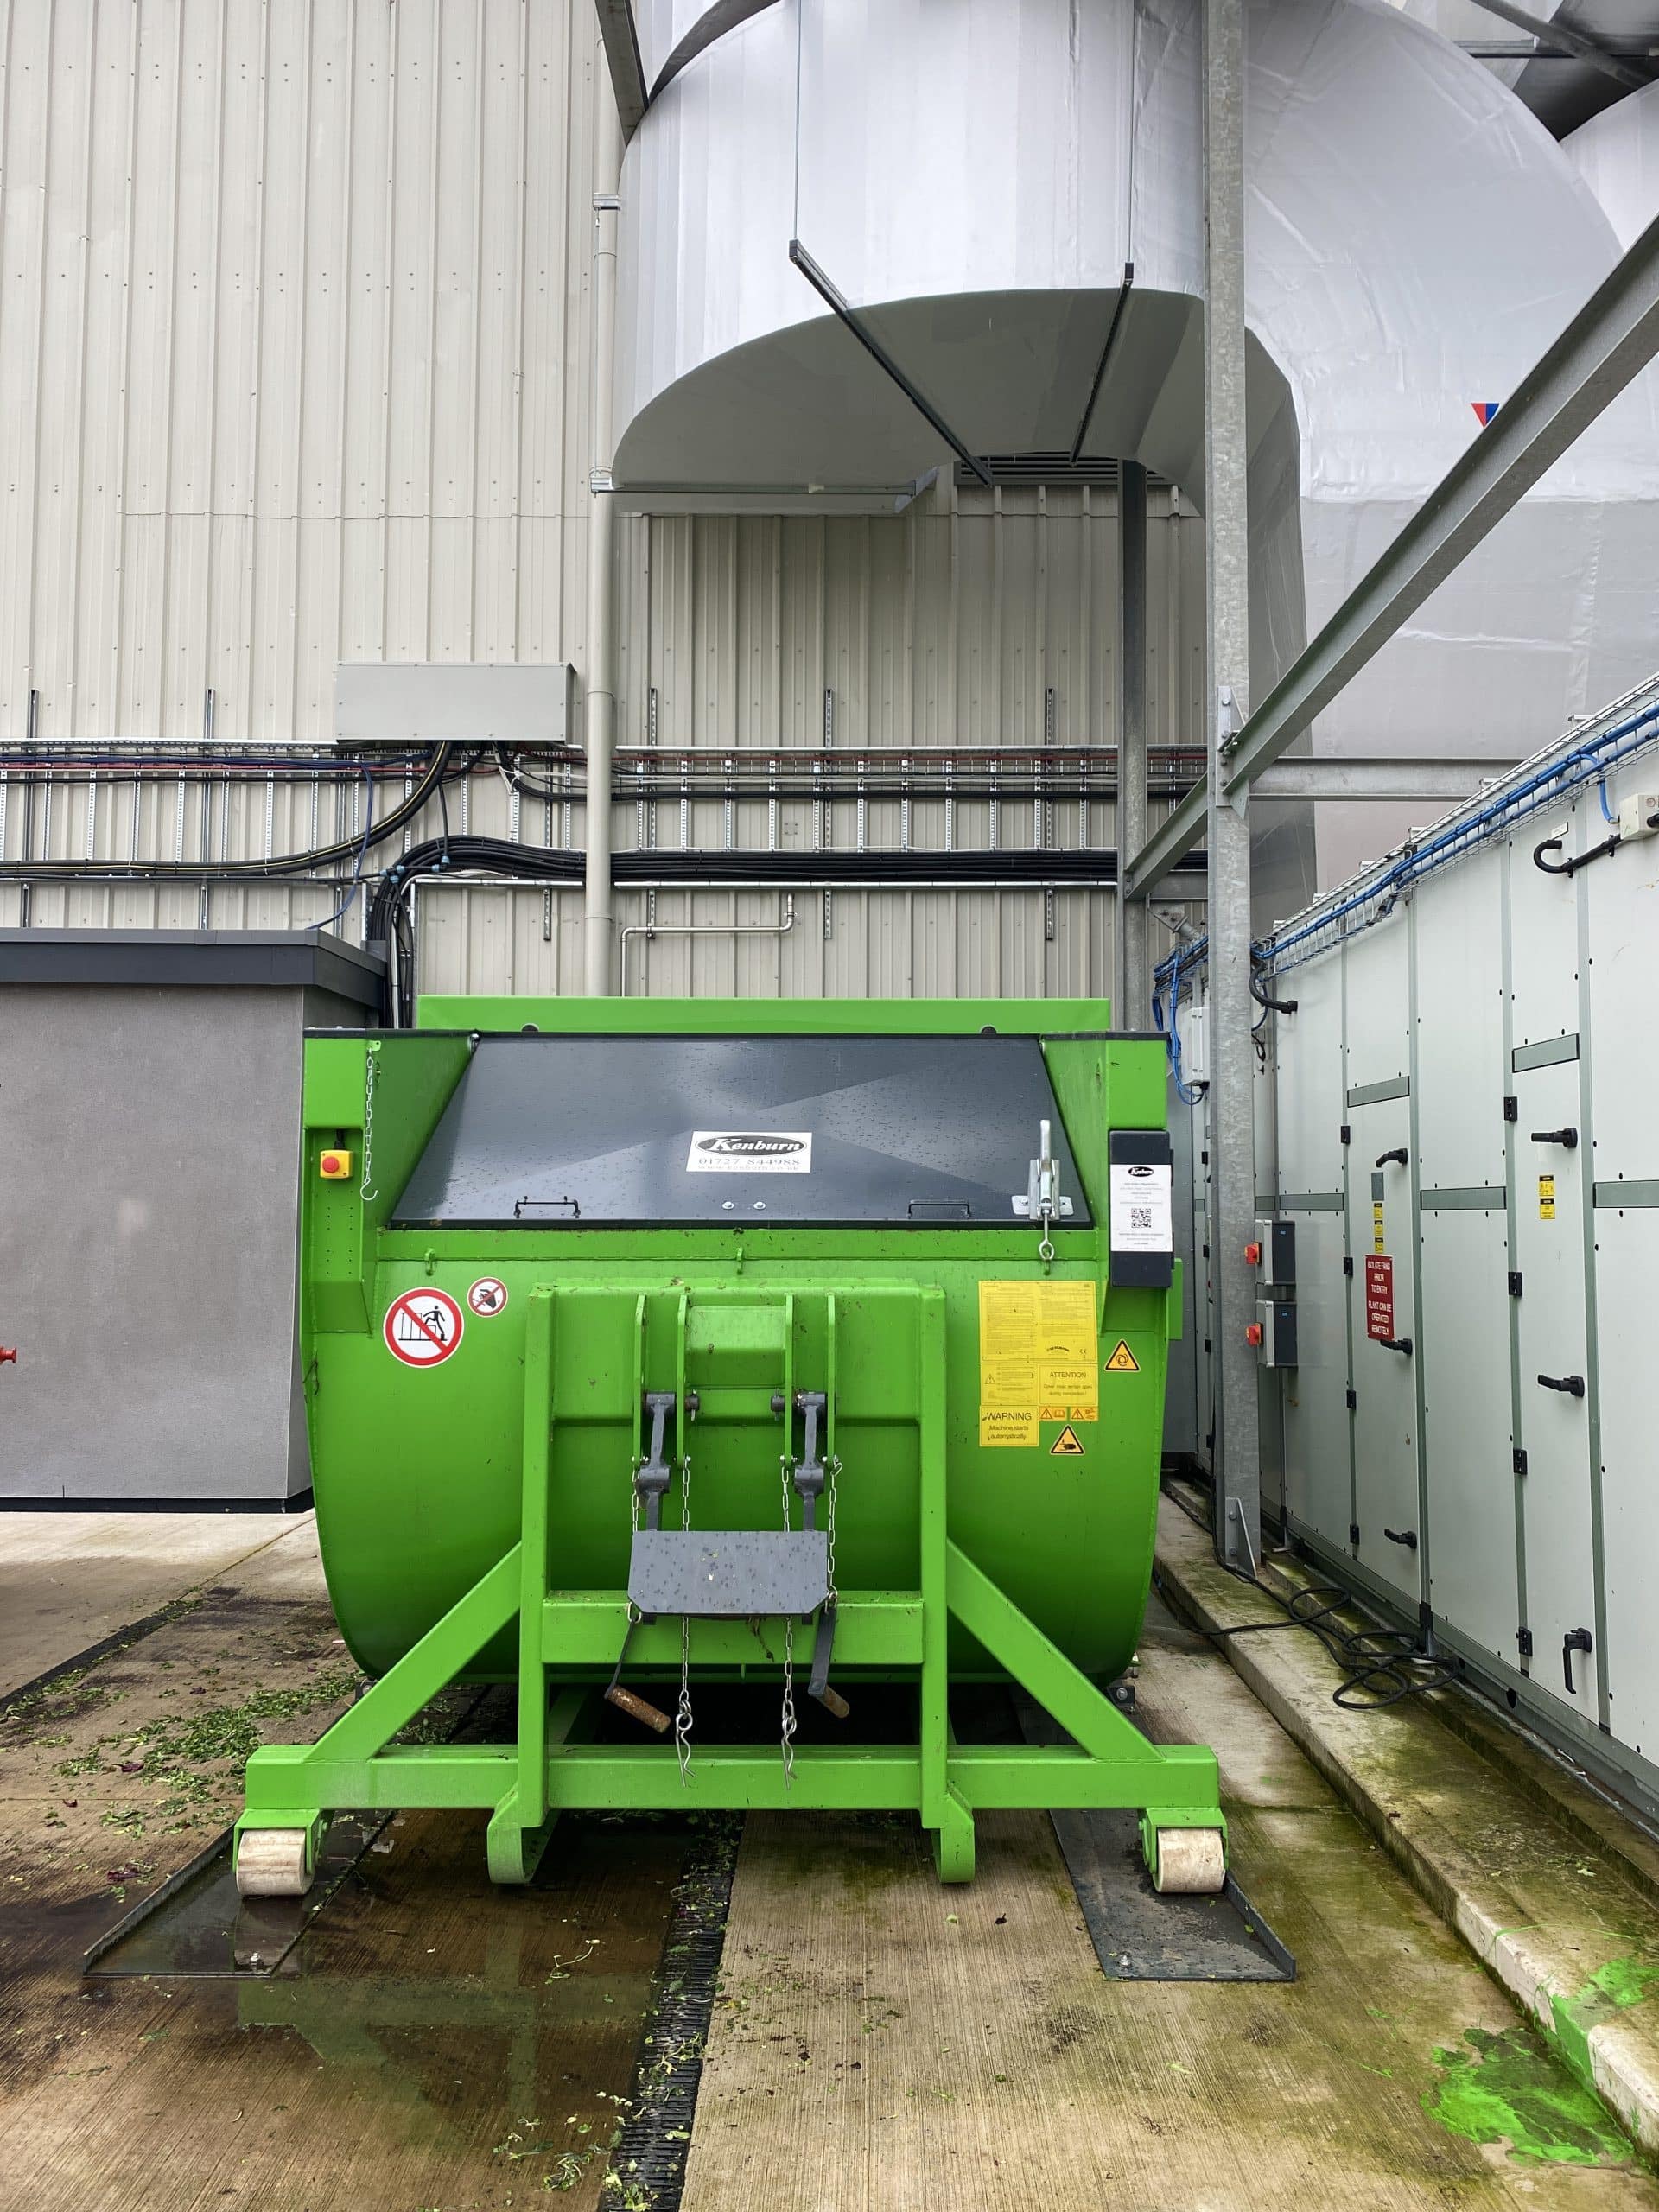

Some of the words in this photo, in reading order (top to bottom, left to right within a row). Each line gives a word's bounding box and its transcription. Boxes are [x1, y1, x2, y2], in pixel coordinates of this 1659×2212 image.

[705, 1138, 801, 1152] Kenburn
[1368, 1300, 1379, 1310] PLANT
[1386, 1304, 1392, 1313] BE
[987, 1412, 1032, 1421] WARNING
